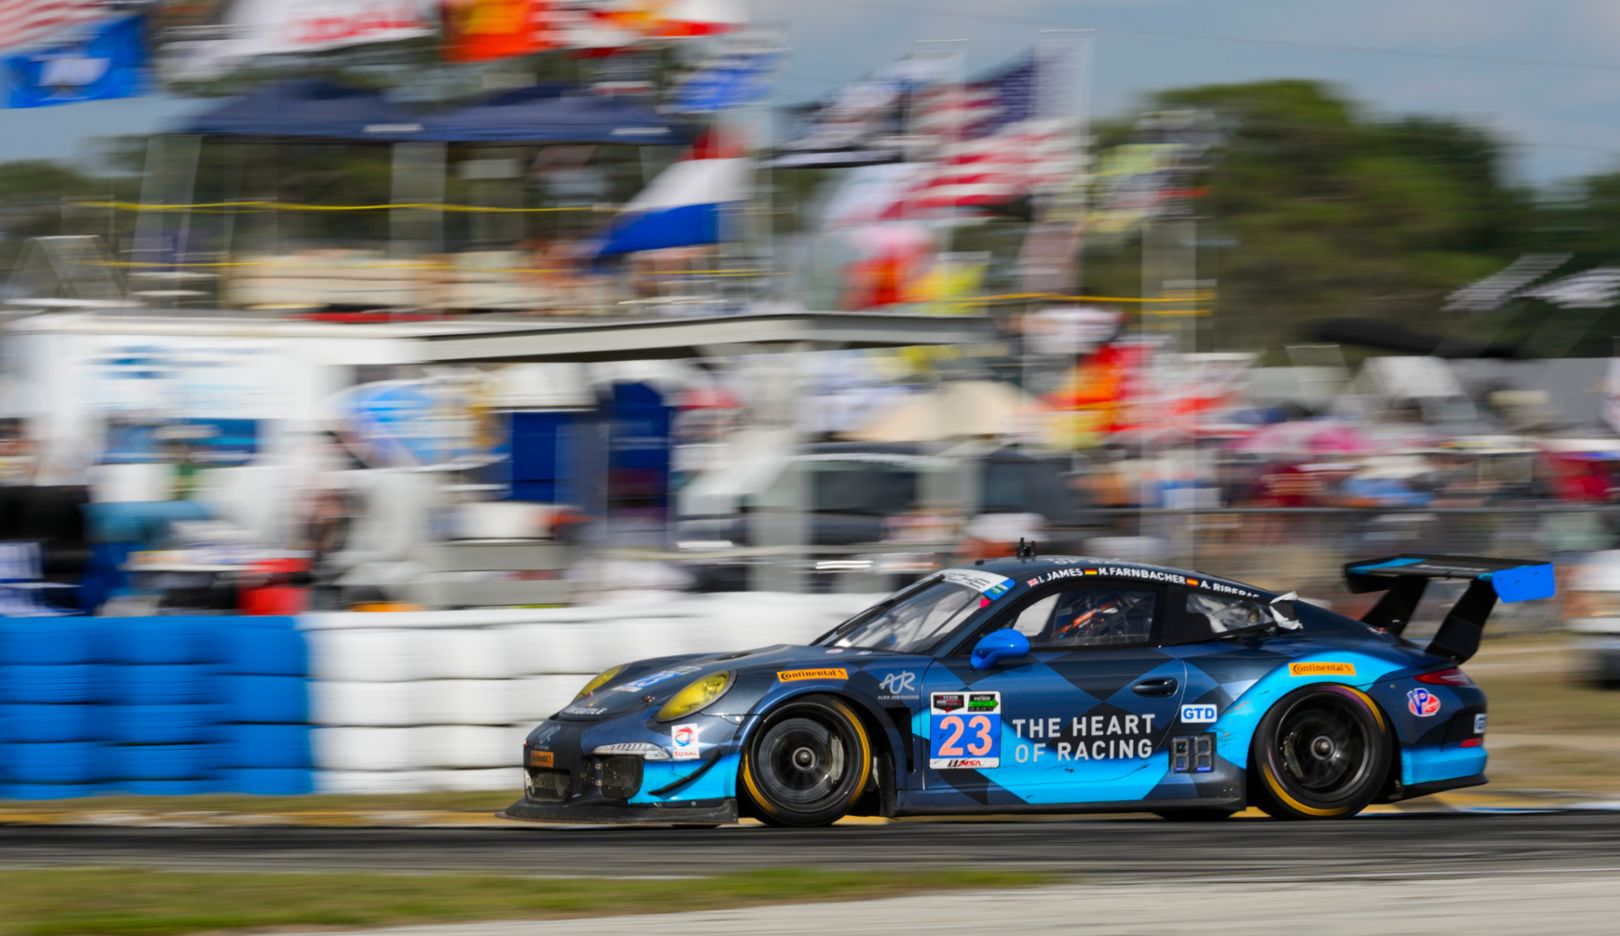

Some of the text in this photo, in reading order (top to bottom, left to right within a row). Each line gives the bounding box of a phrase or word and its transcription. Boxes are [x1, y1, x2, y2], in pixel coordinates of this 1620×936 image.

[1046, 568, 1083, 581] JAMES
[1109, 567, 1186, 585] FARNBACHER
[1200, 580, 1211, 589] A.
[781, 669, 836, 680] Continental
[1293, 664, 1344, 675] Continental
[1183, 707, 1215, 720] GTD
[1012, 714, 1156, 738] THE HEART
[938, 715, 993, 756] 23
[1015, 739, 1153, 764] OF RACING
